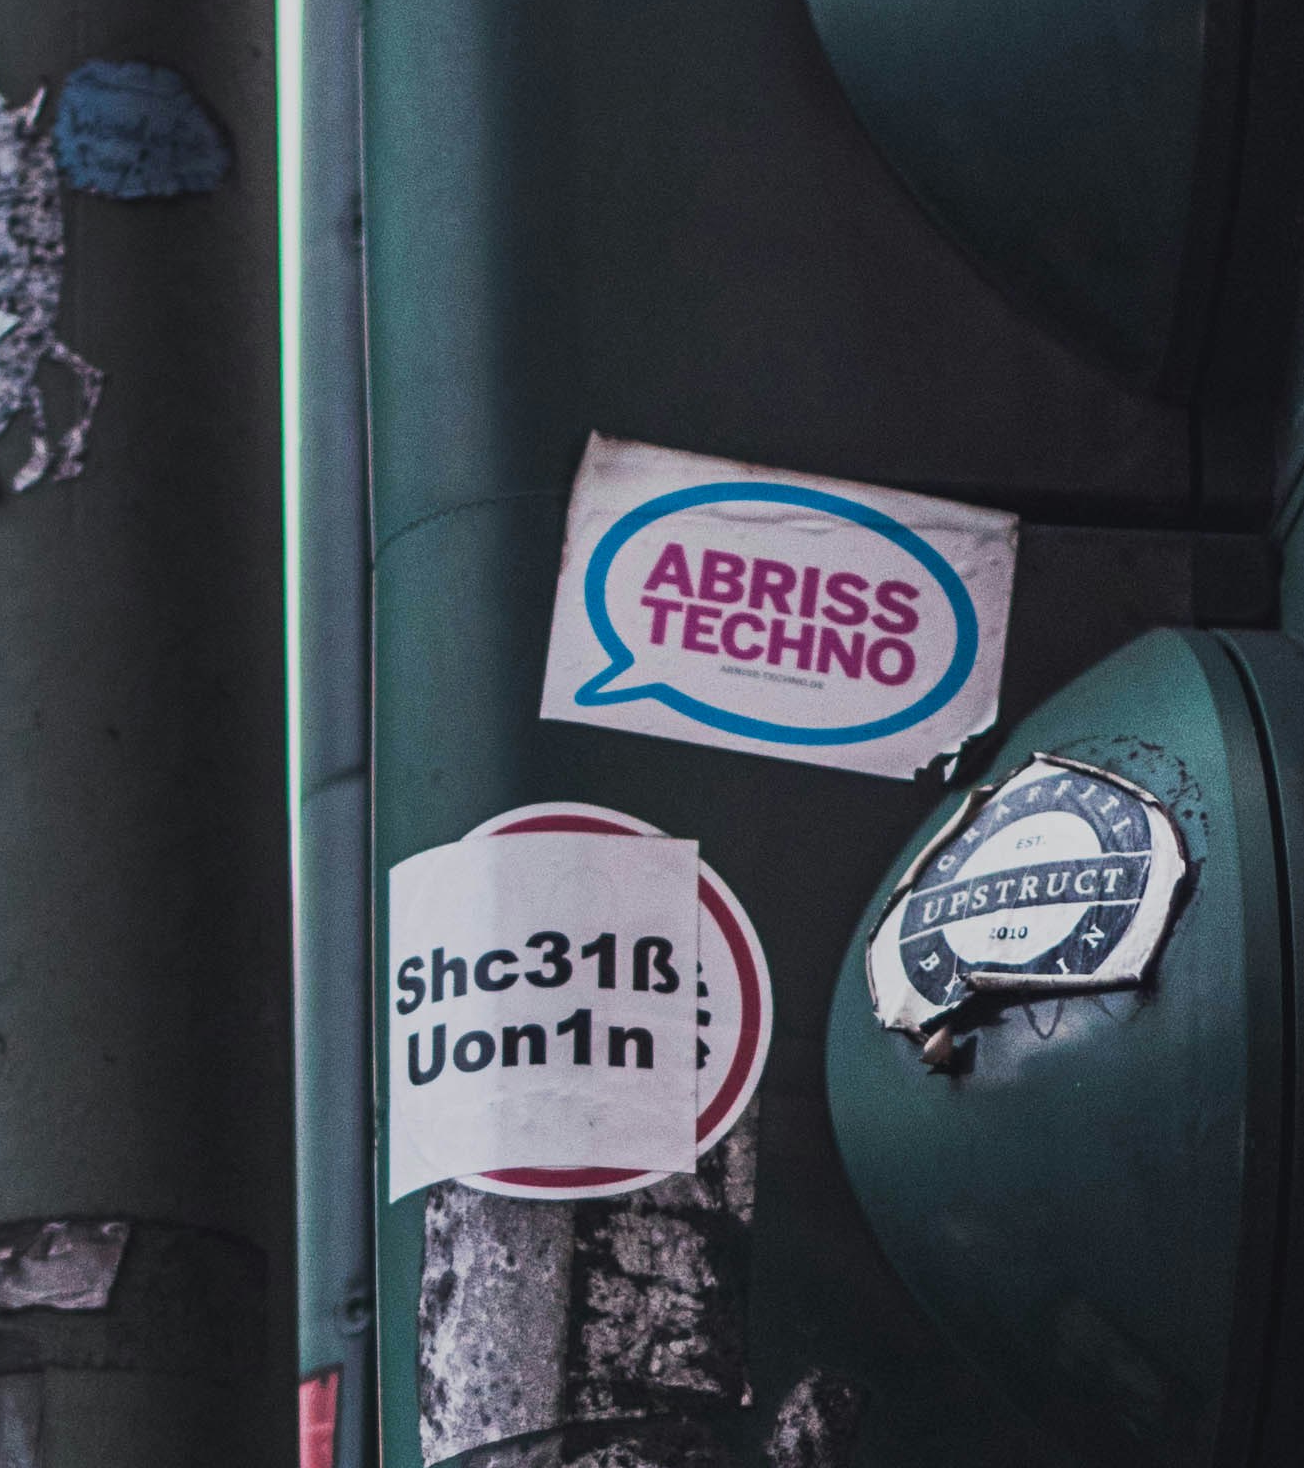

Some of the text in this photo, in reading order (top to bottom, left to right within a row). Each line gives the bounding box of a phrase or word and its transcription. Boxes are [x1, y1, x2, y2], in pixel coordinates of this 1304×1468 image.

[644, 542, 920, 634] ABRISS
[640, 596, 916, 686] TECHNO
[922, 867, 1124, 925] UPSTRUCT
[396, 930, 681, 1016] Shc31ß
[407, 1008, 654, 1086] Uon1n
